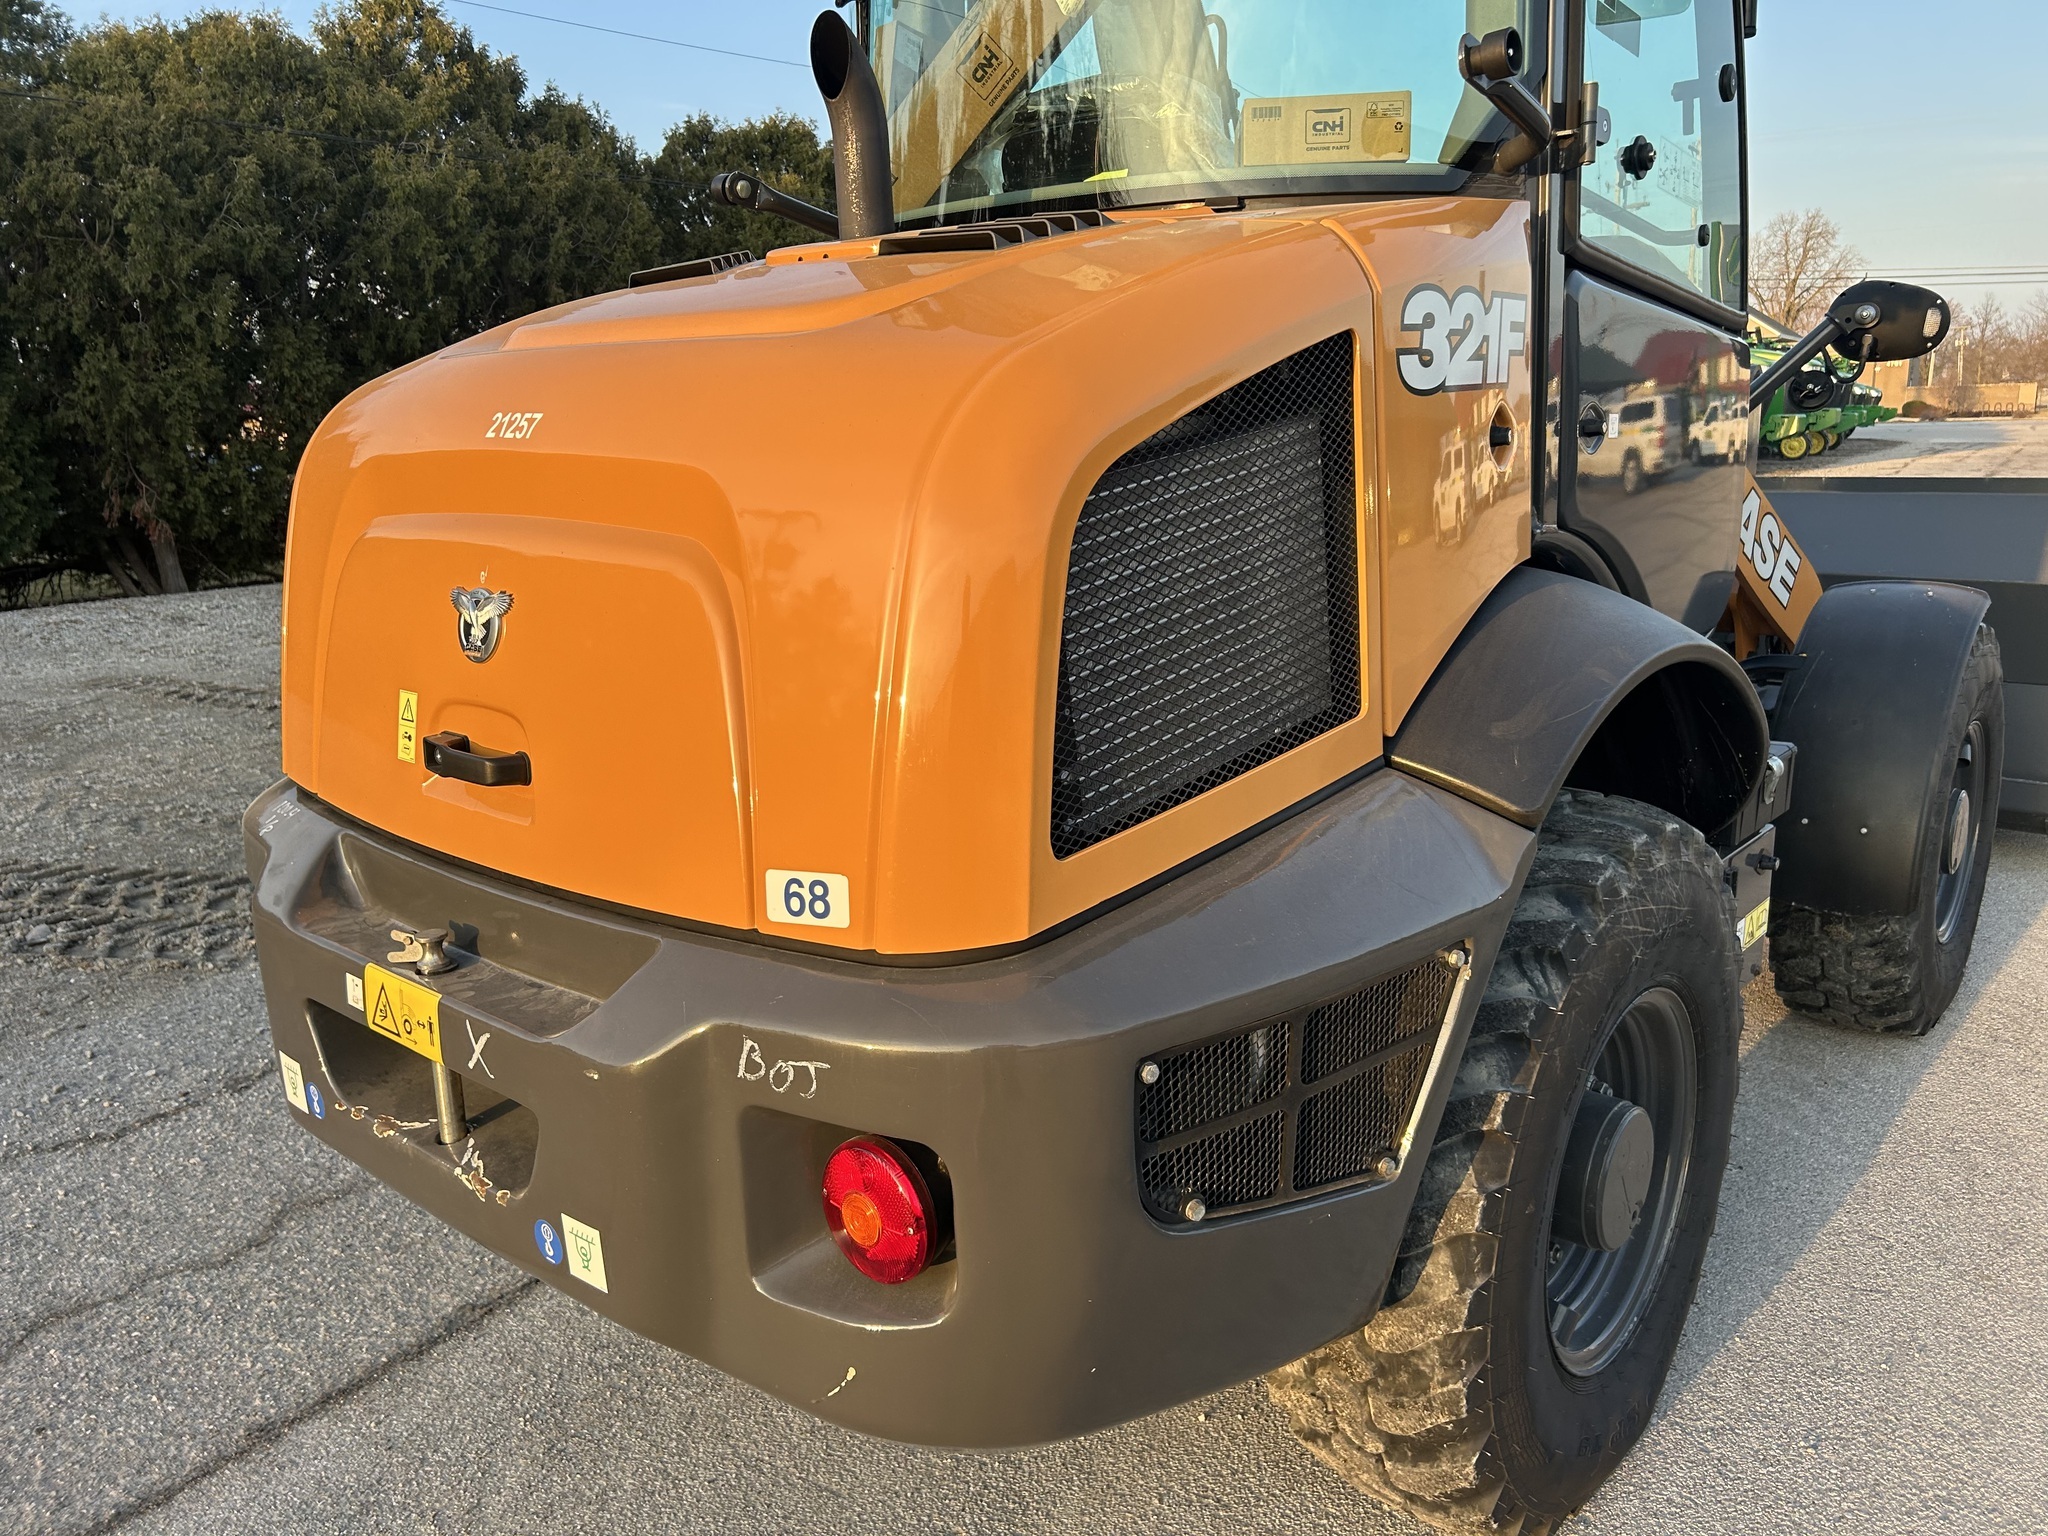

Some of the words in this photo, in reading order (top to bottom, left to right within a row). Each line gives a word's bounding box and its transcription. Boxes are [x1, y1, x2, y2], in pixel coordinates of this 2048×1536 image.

[972, 45, 999, 83] CNH
[981, 61, 1003, 88] INDUSTRIAL
[988, 85, 1008, 107] GENUINE
[1005, 67, 1020, 86] PARTS
[1312, 116, 1343, 132] CNH
[1397, 284, 1527, 395] 321F
[485, 412, 544, 439] 21257
[1740, 486, 1802, 611] ASE
[783, 876, 831, 920] 68
